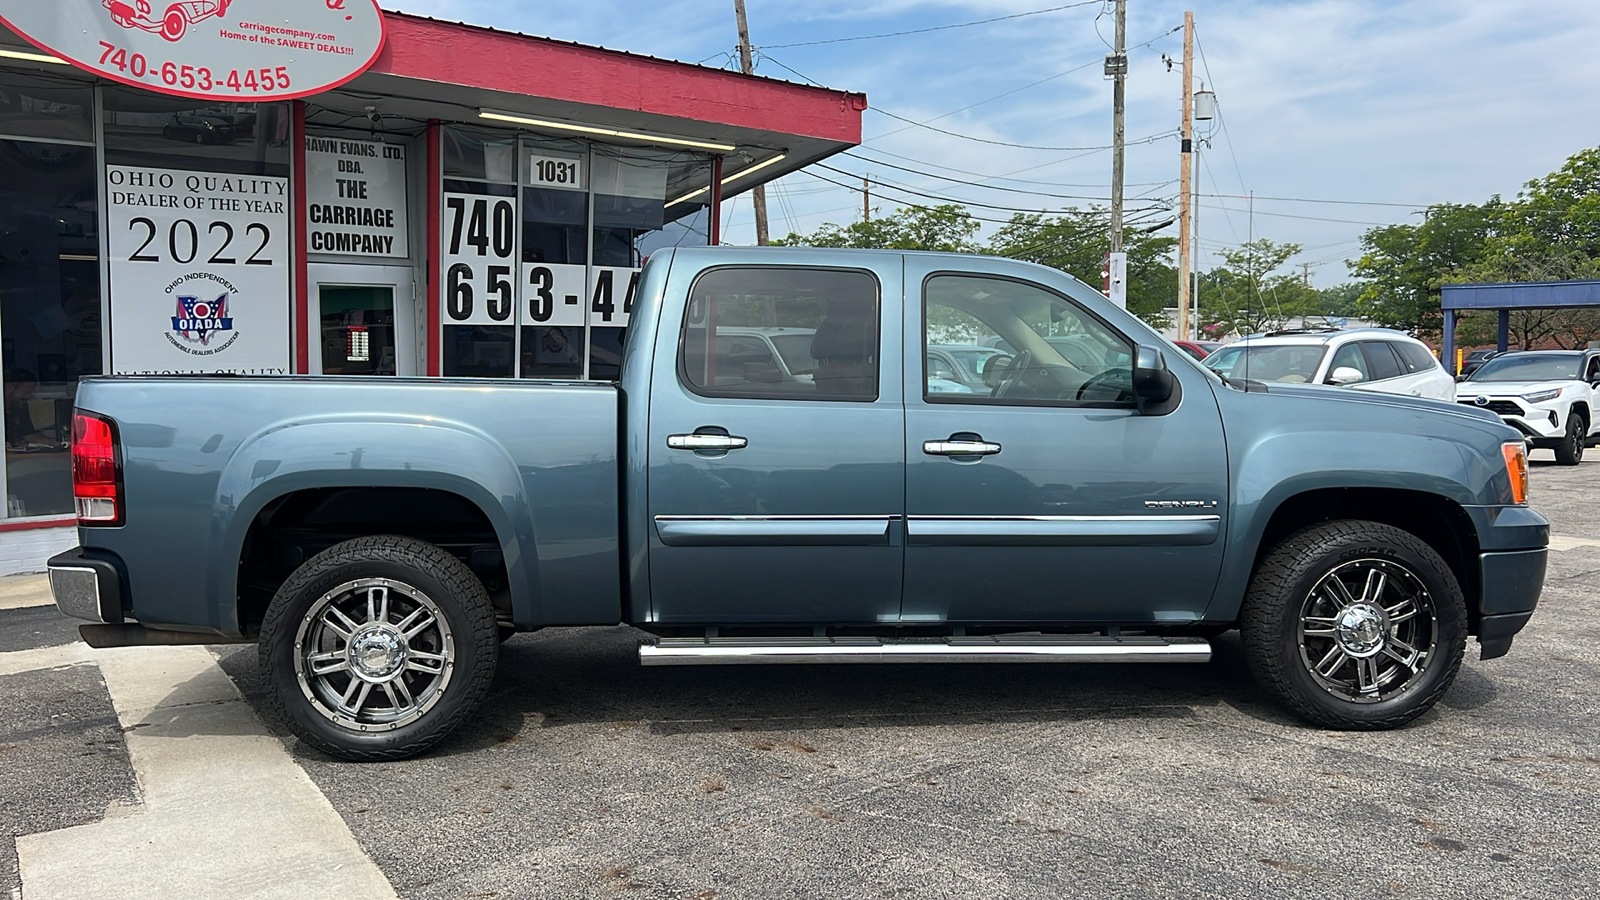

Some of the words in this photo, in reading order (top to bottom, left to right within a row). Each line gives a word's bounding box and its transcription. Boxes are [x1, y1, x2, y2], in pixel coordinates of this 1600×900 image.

[219, 29, 247, 41] Home
[248, 34, 259, 43] of
[260, 36, 276, 45] the
[277, 38, 315, 51] SAWEET
[316, 43, 354, 55] DEALS!!!
[238, 21, 336, 42] carriagecompany.com
[98, 40, 291, 93] 740-653-4455
[340, 141, 378, 158] EVANS.
[382, 146, 404, 160] LTD.
[337, 159, 364, 174] DBA.
[535, 159, 576, 184] 1031
[108, 169, 174, 189] OHIO
[185, 175, 287, 196] QUALITY
[335, 178, 368, 200] THE
[112, 191, 180, 208] DEALER
[183, 195, 205, 210] OF
[207, 198, 241, 212] THE
[244, 200, 284, 214] YEAR
[309, 203, 394, 228] CARRIAGE
[446, 196, 514, 259] 740
[127, 216, 273, 266] 2022
[311, 231, 394, 254] COMPANY
[164, 277, 184, 294] OHIO
[184, 272, 240, 295] INDEPENDENT
[178, 318, 223, 330] OIADA
[1144, 499, 1218, 509] DENALI
